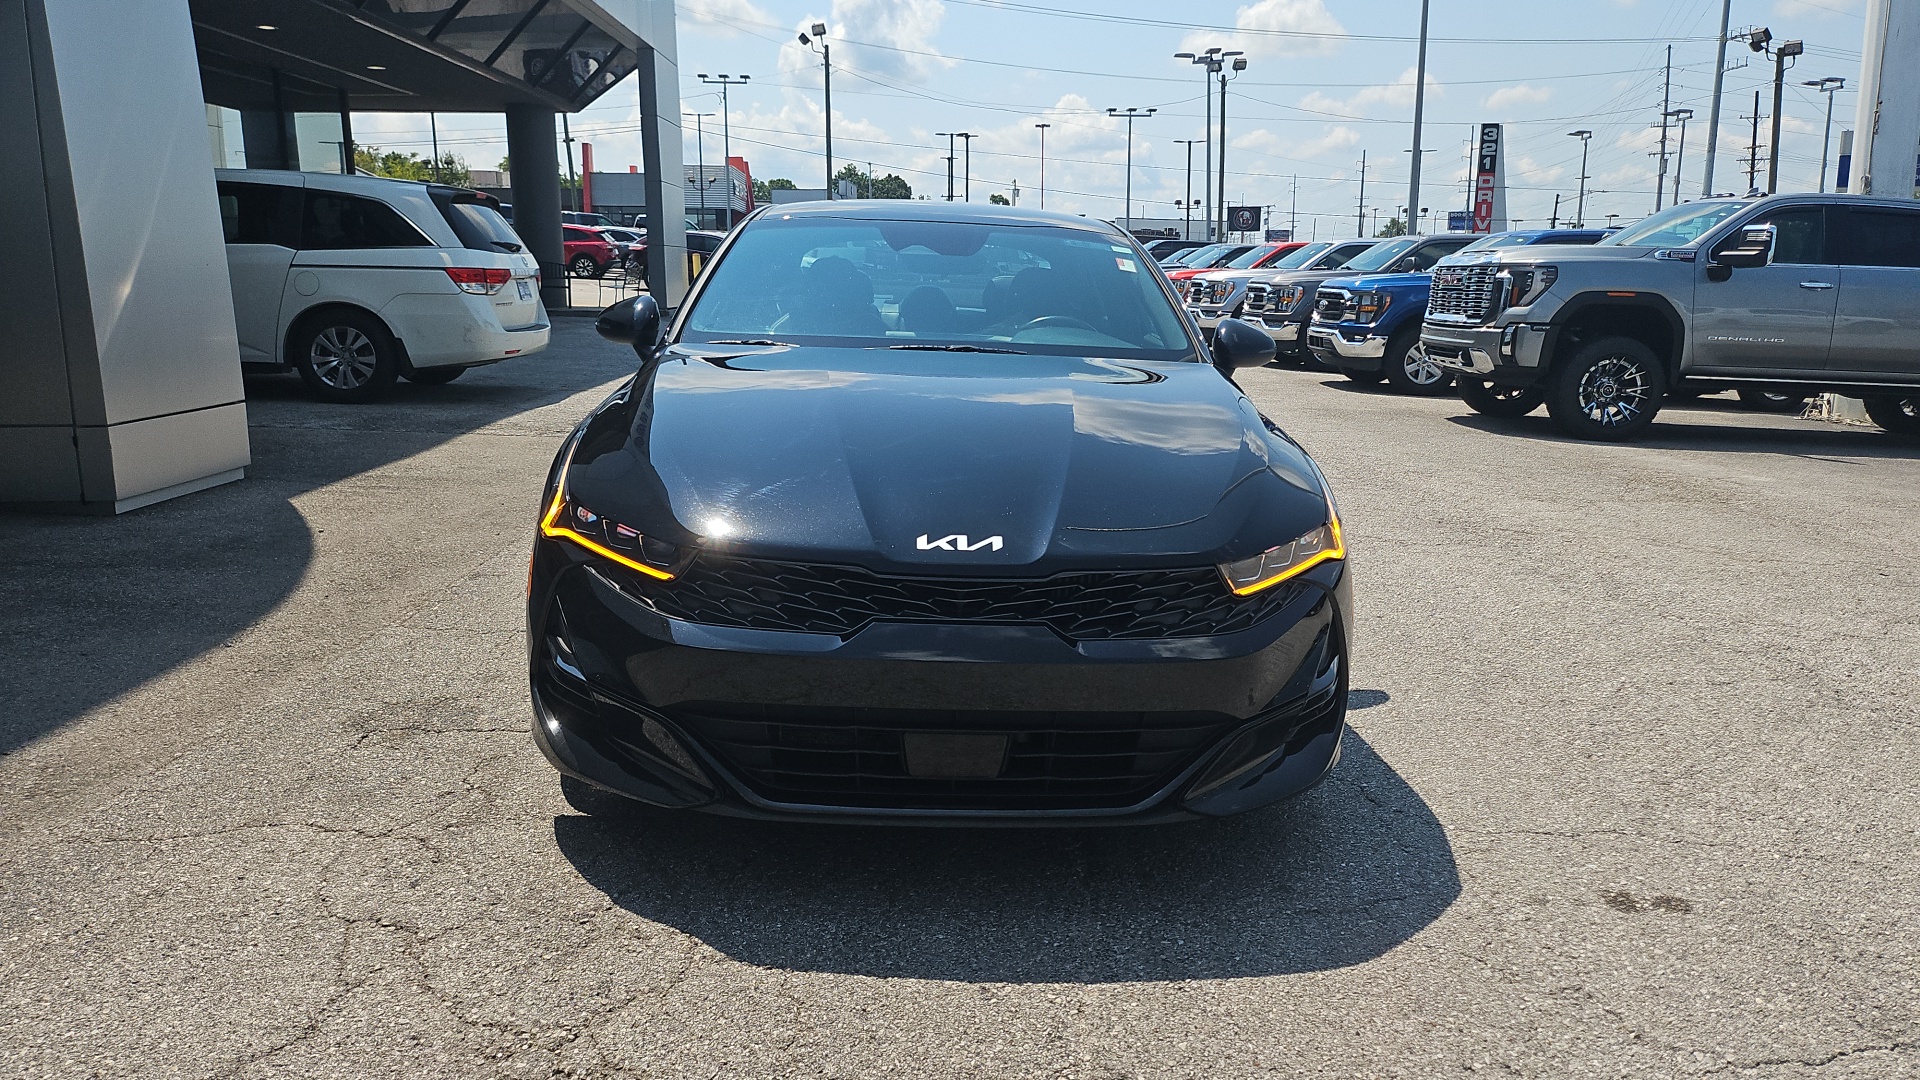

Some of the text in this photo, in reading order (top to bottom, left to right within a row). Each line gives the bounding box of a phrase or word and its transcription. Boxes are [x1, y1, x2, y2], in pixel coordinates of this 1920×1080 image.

[1474, 128, 1498, 234] 321 DRIV
[916, 533, 1004, 552] KIA
